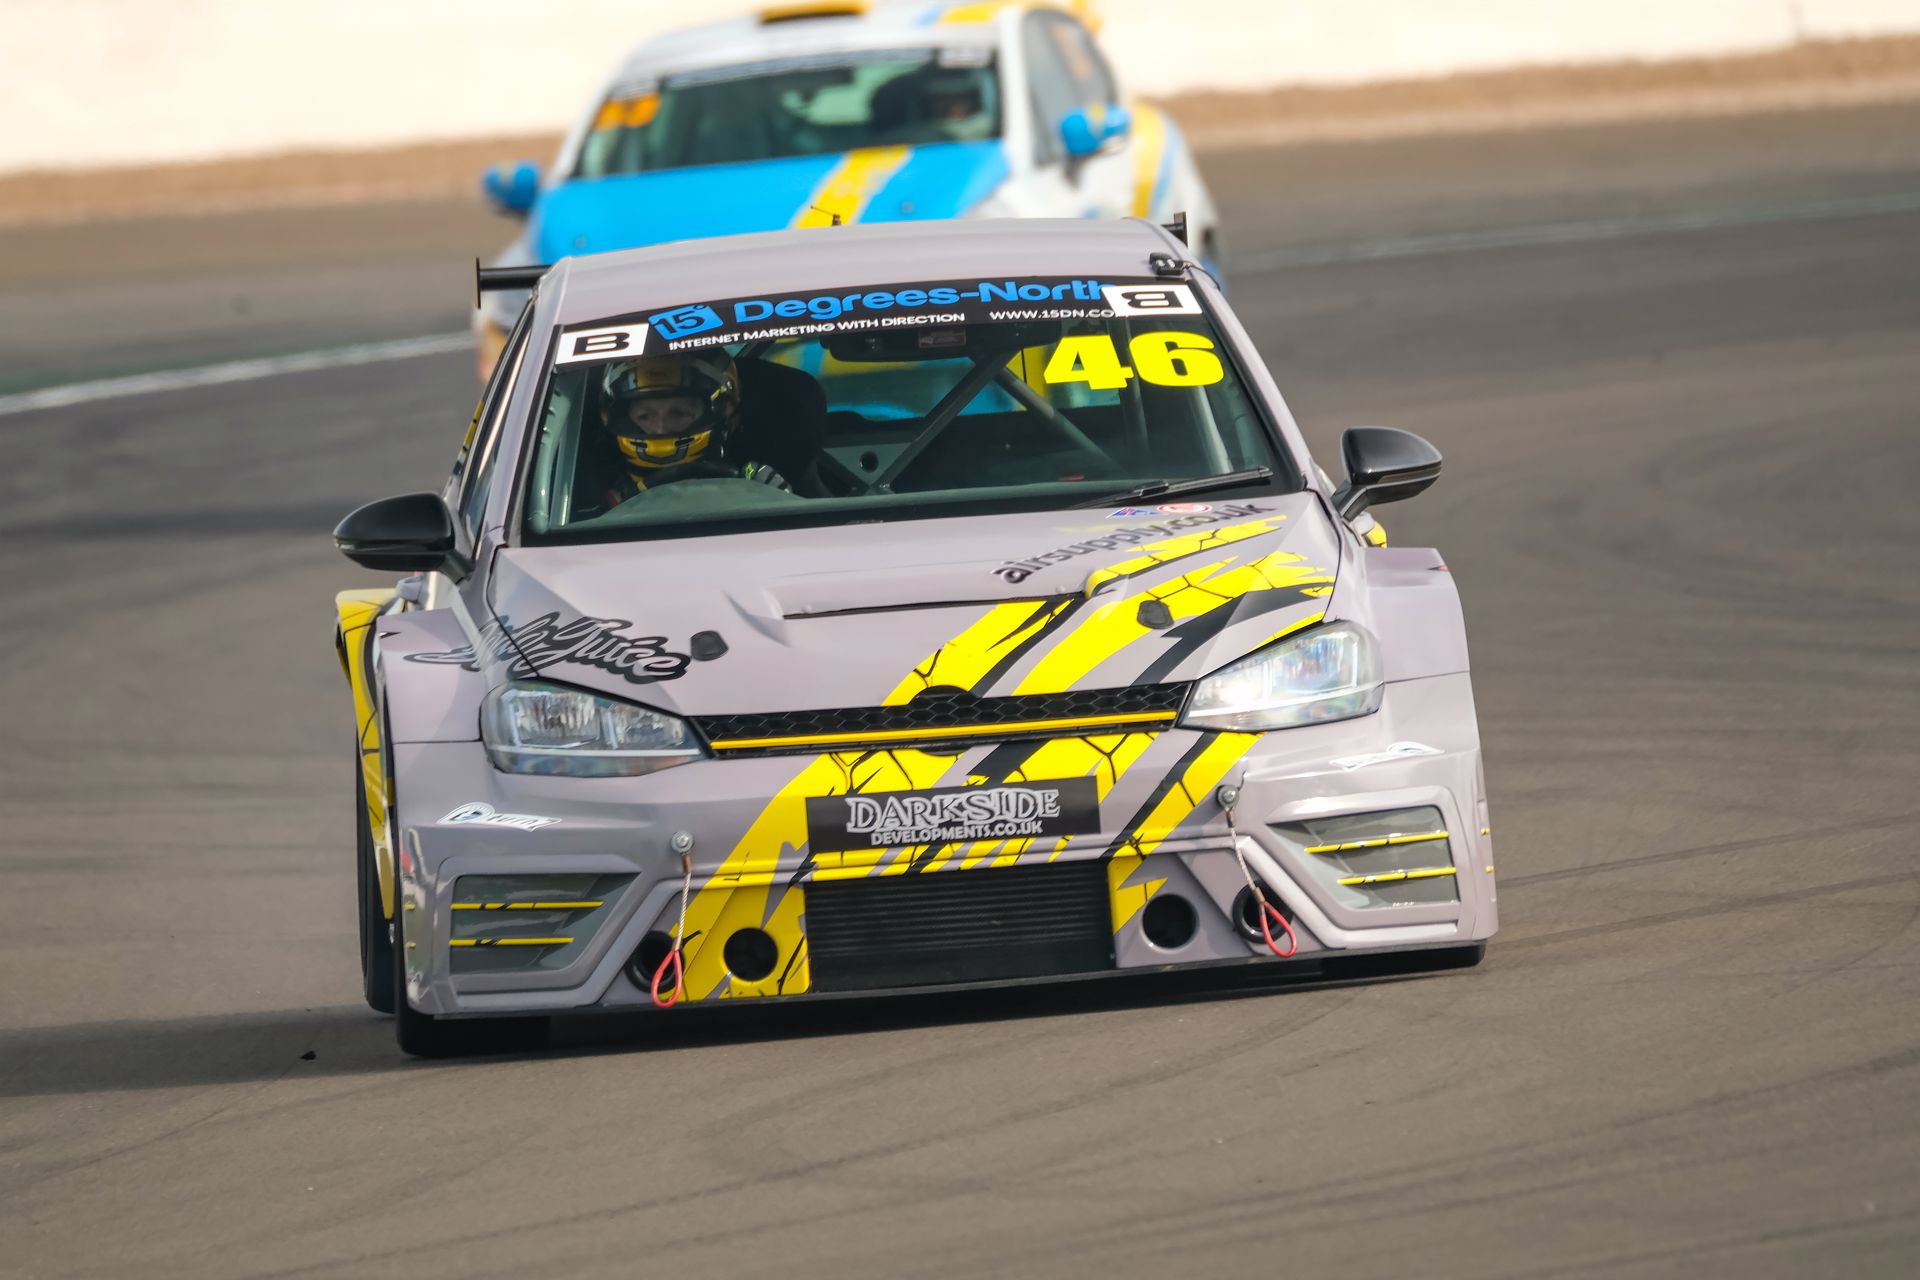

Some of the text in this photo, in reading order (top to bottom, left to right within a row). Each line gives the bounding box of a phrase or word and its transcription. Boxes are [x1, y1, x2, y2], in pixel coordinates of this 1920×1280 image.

[669, 312, 965, 351] INTERNET MARKETING WITH DIRECTION
[989, 308, 1129, 320] WWW.15DN.CO
[572, 331, 631, 356] B
[1043, 331, 1224, 390] 46
[991, 502, 1277, 584] airsupply.co.uk
[845, 787, 1061, 833] DARKSIDE
[871, 820, 1044, 846] DEVELOPMENTS.CO.UK
